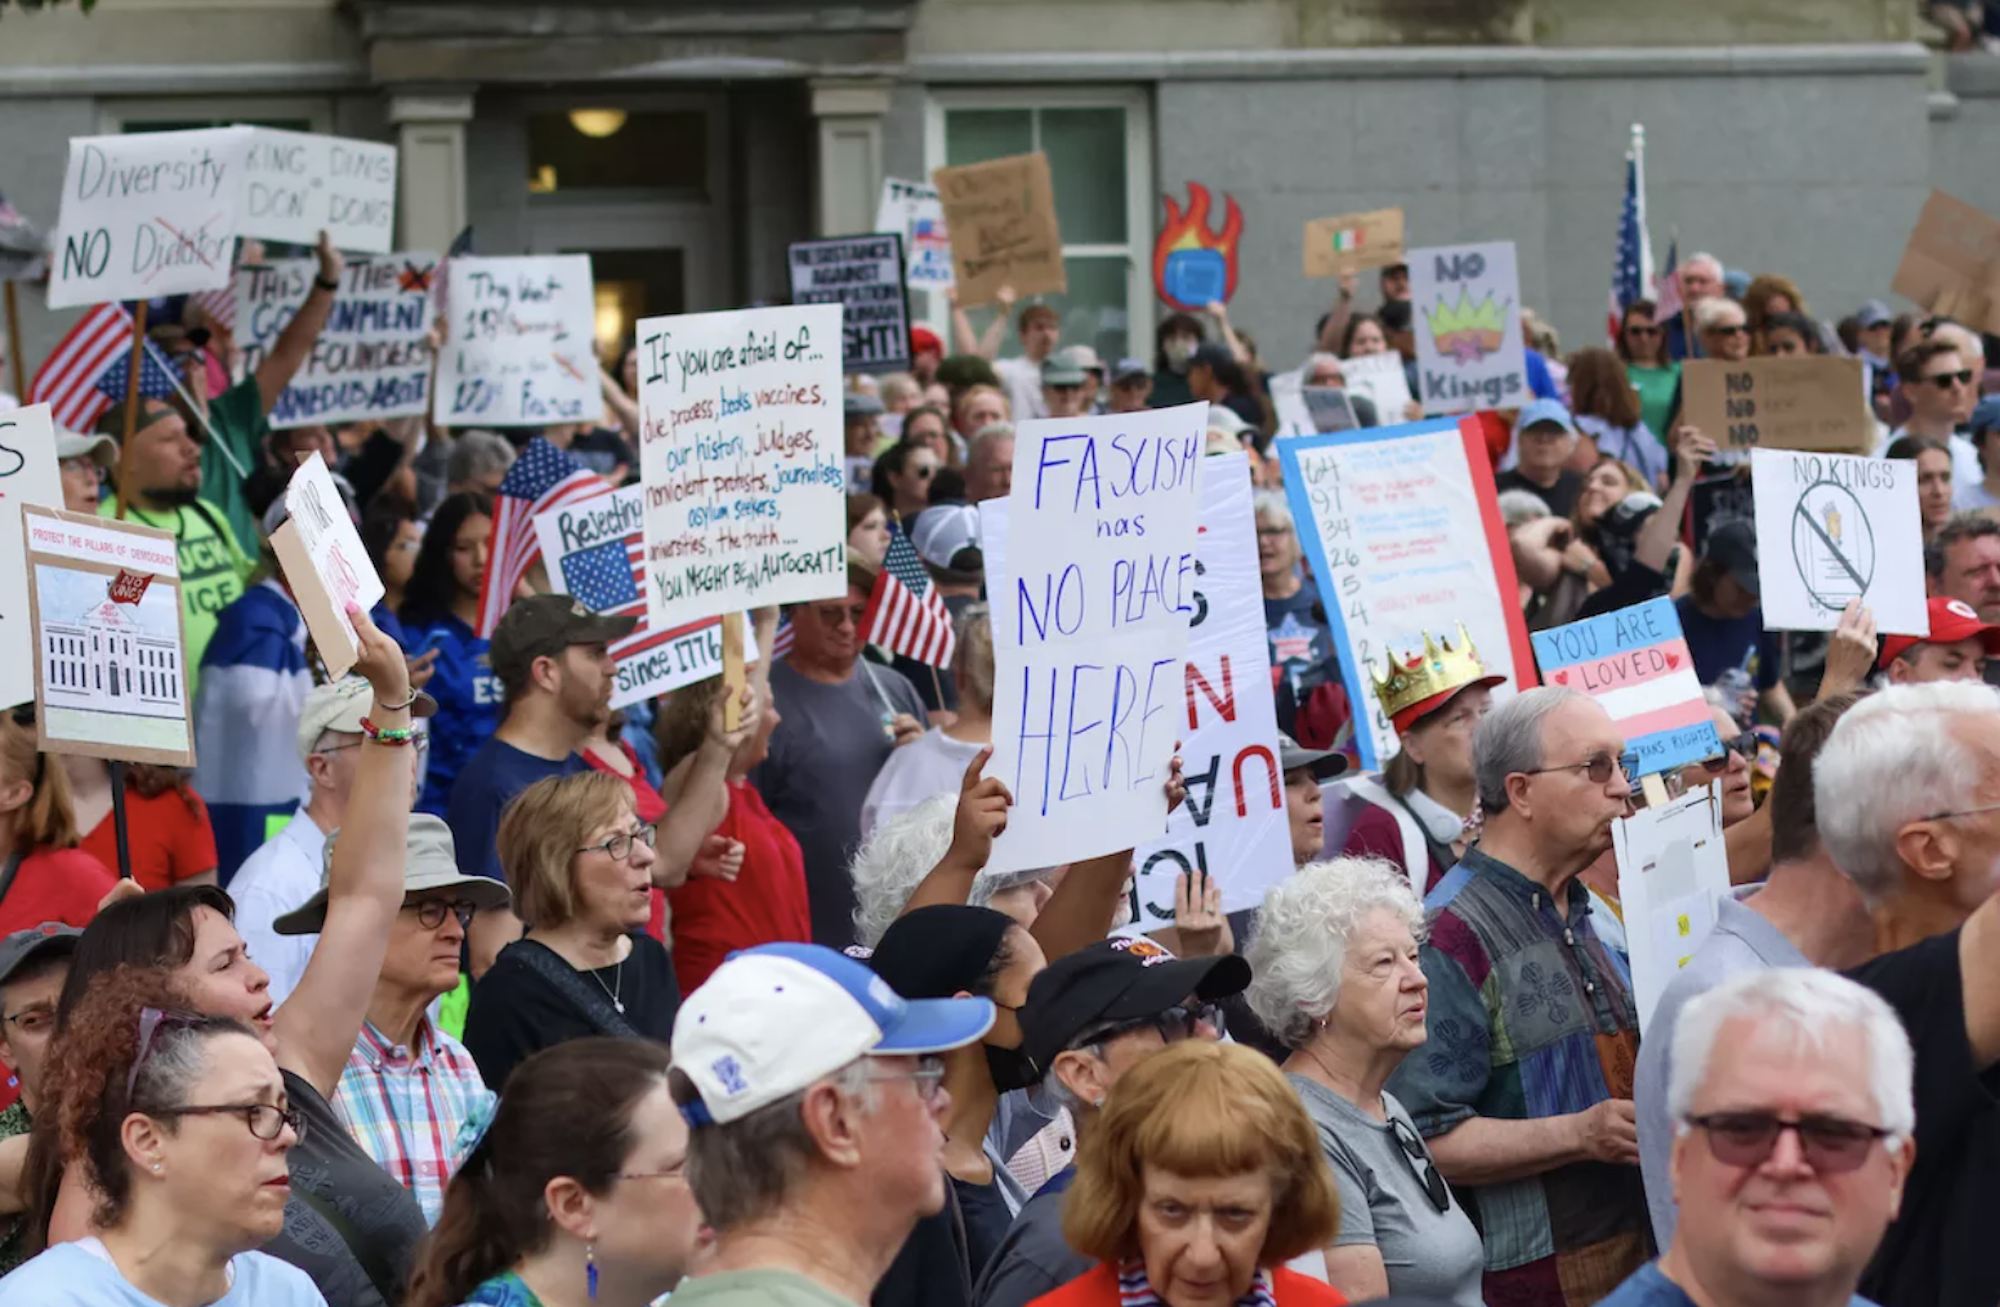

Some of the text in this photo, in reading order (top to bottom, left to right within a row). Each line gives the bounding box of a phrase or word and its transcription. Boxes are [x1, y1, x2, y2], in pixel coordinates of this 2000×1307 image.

[78, 145, 226, 200] Diversity
[245, 143, 306, 176] KING
[63, 228, 111, 281] NO
[1434, 252, 1486, 283] NO
[240, 260, 398, 302] THIS THE
[644, 332, 672, 384] If
[676, 350, 708, 393] you
[711, 346, 736, 372] are
[739, 330, 777, 366] afraid
[1726, 372, 1753, 395] NO
[644, 404, 669, 443] due
[754, 383, 827, 407] vaccines,
[1726, 397, 1756, 418] NO
[667, 446, 691, 473] our
[754, 420, 819, 459] judges,
[1729, 422, 1760, 445] NO
[1035, 429, 1199, 513] FASCISM
[1304, 456, 1340, 484] 64
[1793, 456, 1894, 489] NO KINGS
[688, 496, 729, 530] asylum
[1311, 488, 1343, 514] 97
[717, 526, 742, 553] the
[1324, 518, 1351, 541] 34
[33, 528, 174, 567] PROTECT THE PILLARS OF DEMOCRACY
[1330, 547, 1360, 571] 26
[122, 575, 143, 588] NO
[655, 569, 684, 608] YOU
[686, 562, 730, 598] MIGHT
[760, 541, 844, 583] AUTOCRAT!
[1341, 575, 1362, 597] 5
[111, 585, 144, 603] KINGS
[186, 581, 234, 616] ICE
[1018, 563, 1085, 646] NO
[1112, 552, 1193, 628] PLACE
[1350, 601, 1369, 626] 4
[1548, 609, 1662, 662] YOU ARE
[617, 630, 724, 692] since 1776
[1580, 648, 1666, 691] LOVED
[1015, 658, 1176, 816] HERE
[1631, 722, 1718, 757] TRANS RIGHTS!
